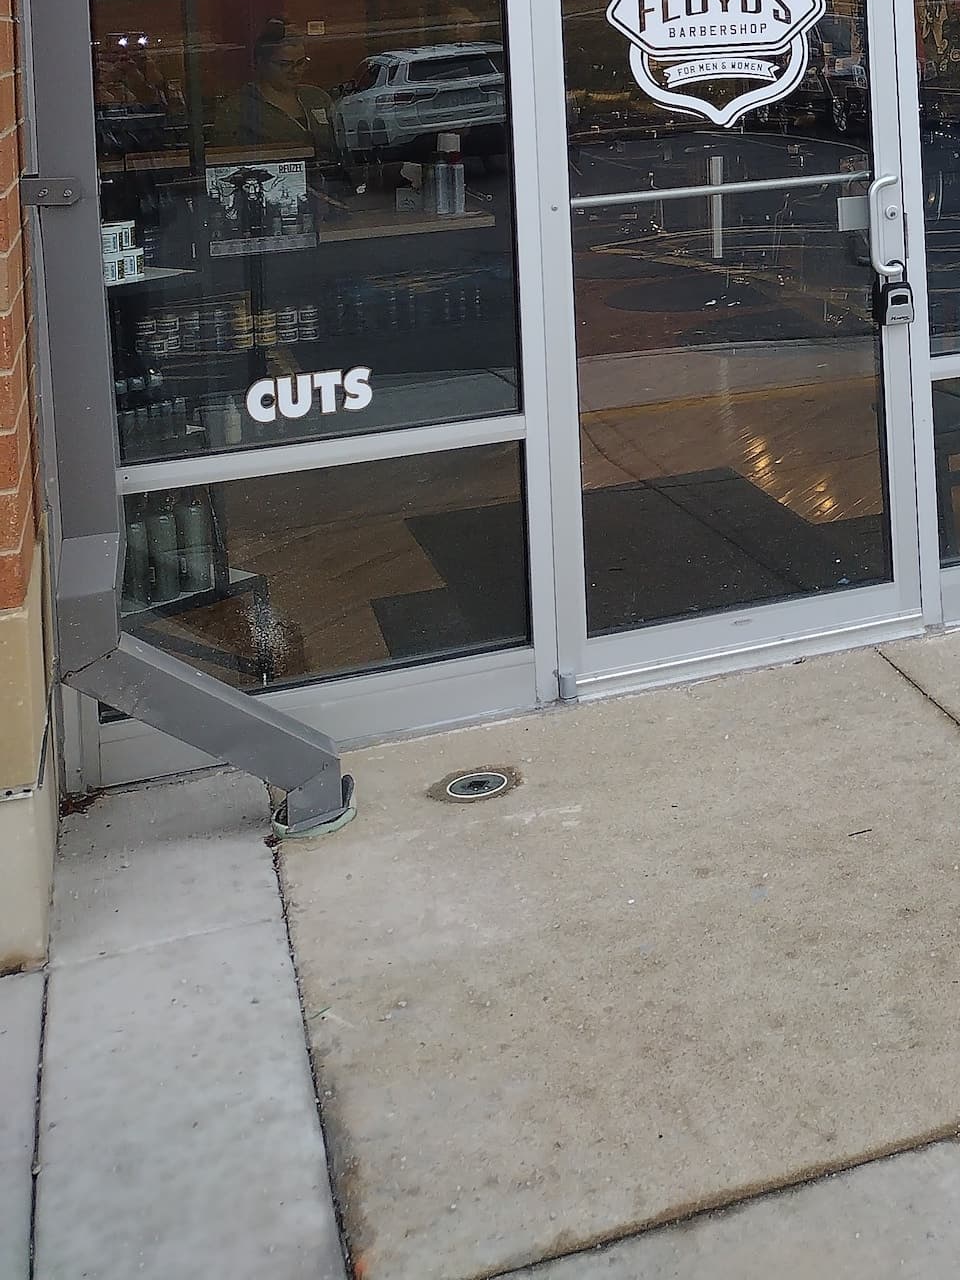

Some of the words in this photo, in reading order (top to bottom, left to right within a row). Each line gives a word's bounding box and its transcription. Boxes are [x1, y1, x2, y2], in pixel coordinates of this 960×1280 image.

[669, 23, 767, 38] BARBERSHOP
[677, 65, 696, 76] FOR
[699, 62, 718, 72] MEN
[721, 61, 727, 70] &
[731, 61, 763, 71] WOMEN
[246, 366, 373, 422] CUTS
